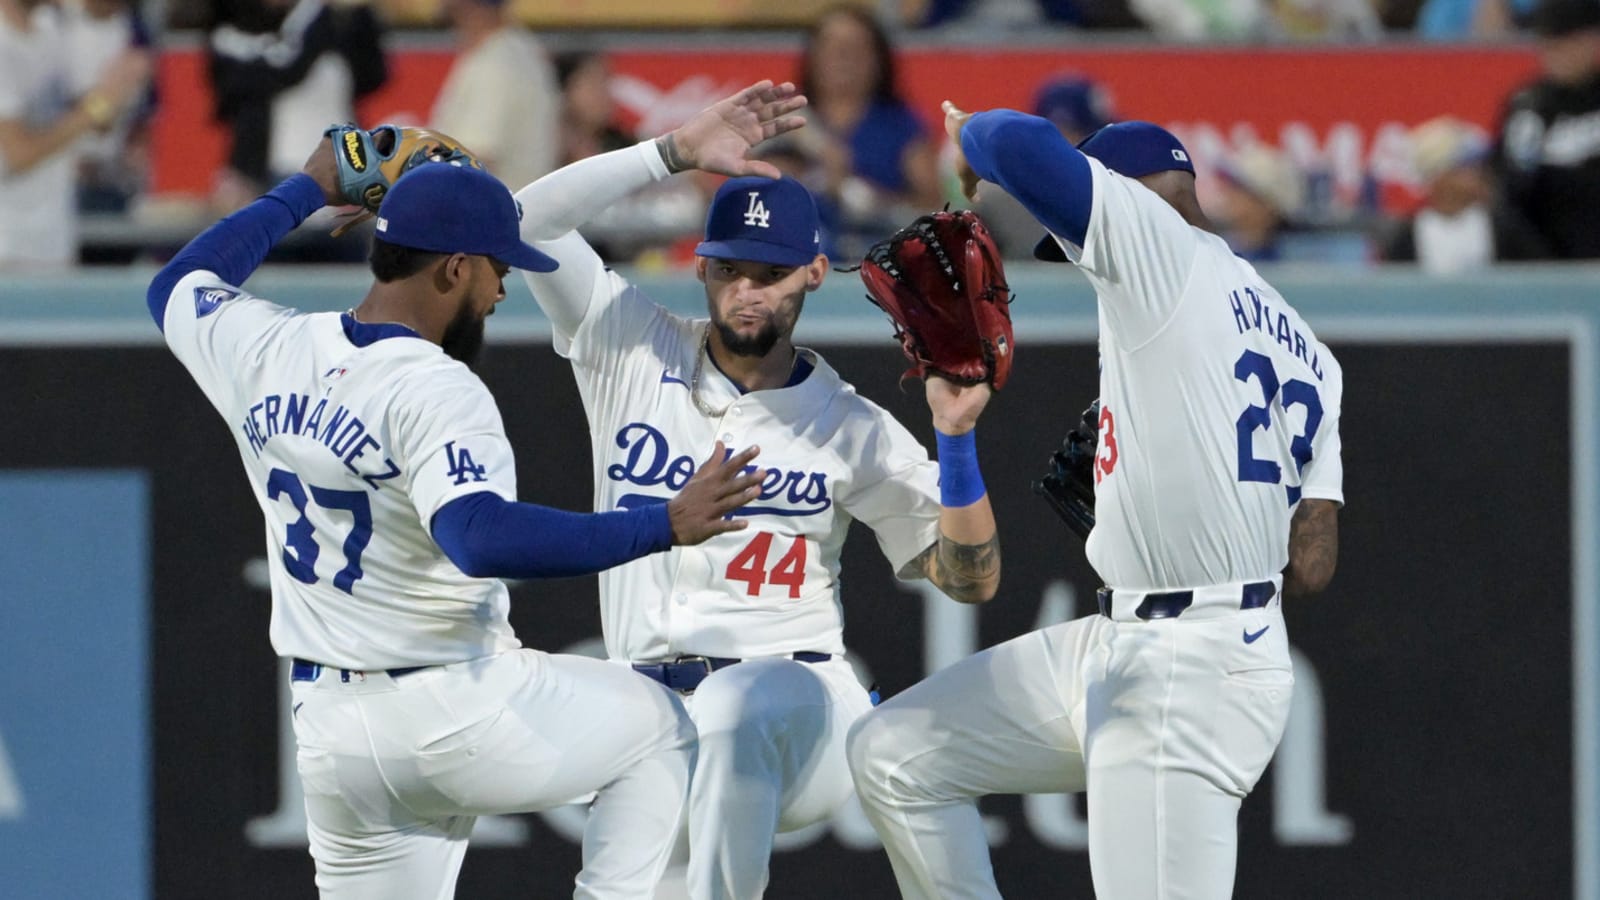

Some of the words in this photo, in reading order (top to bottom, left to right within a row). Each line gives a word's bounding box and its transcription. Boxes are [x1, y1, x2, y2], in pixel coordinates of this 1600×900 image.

[344, 131, 364, 169] Wilson
[743, 192, 770, 228] LA
[243, 387, 401, 490] HERNÁNDEZ
[445, 440, 488, 486] LA
[1094, 405, 1118, 485] 3
[1234, 348, 1324, 508] 23
[607, 422, 832, 520] Doers
[267, 467, 373, 596] 37
[725, 531, 807, 599] 44
